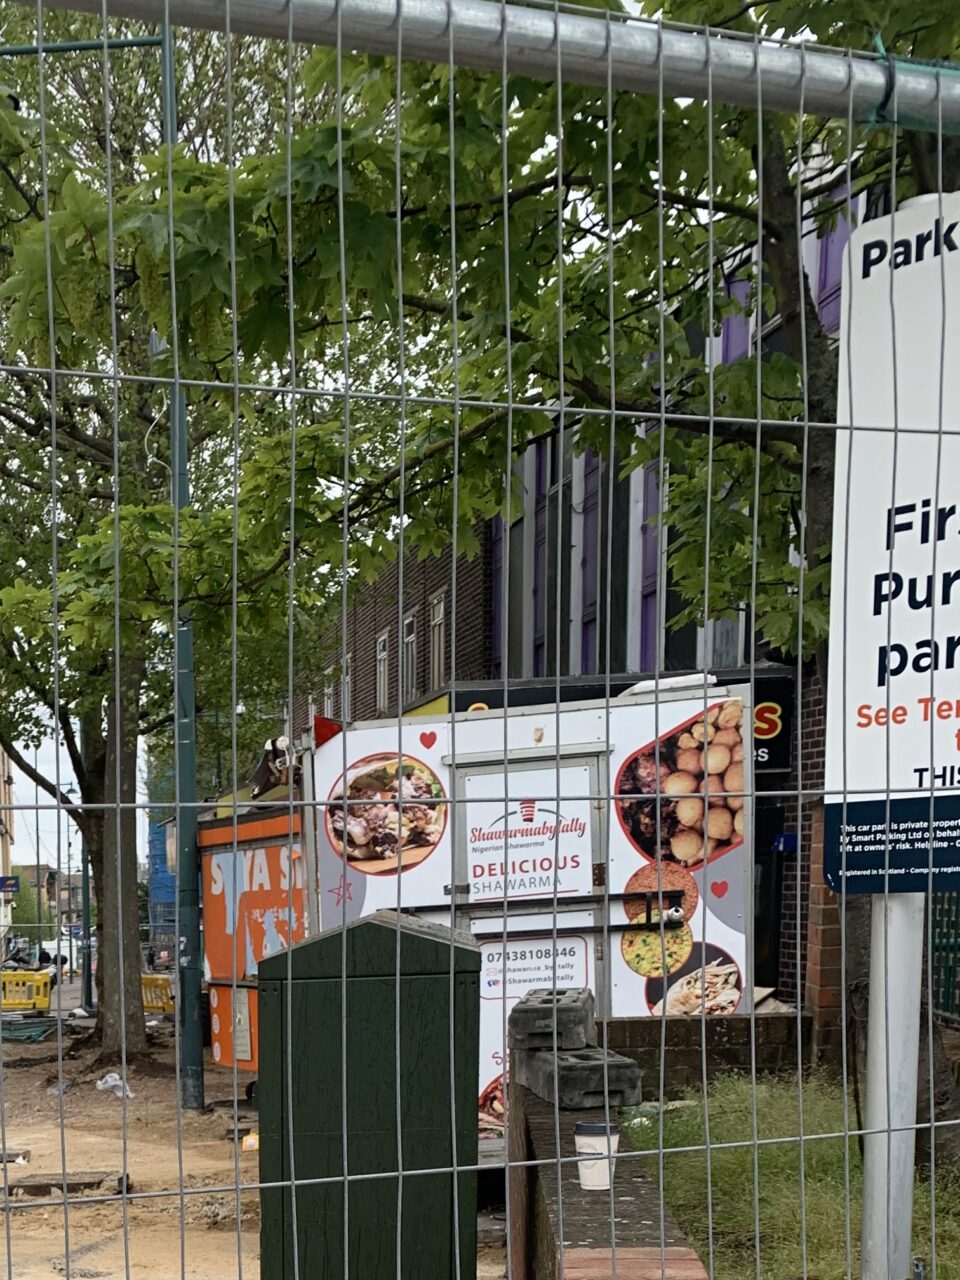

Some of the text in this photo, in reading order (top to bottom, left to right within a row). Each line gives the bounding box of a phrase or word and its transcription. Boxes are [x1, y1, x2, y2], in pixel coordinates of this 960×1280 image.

[861, 217, 959, 279] Park
[886, 498, 960, 550] Fir
[856, 704, 908, 728] See
[872, 823, 888, 833] par
[891, 822, 898, 830] is
[900, 821, 928, 831] private
[852, 834, 874, 843] Smart
[876, 831, 906, 842] Paking
[908, 831, 921, 839] Ltd
[936, 829, 960, 838] behal
[472, 845, 504, 854] Nigerian
[840, 844, 853, 853] lft
[854, 844, 862, 852] at
[864, 843, 895, 852] ownes'
[896, 842, 913, 850] risk.
[211, 849, 271, 895] SYA
[473, 855, 580, 878] DELICIOUS
[839, 869, 871, 877] Rgistered
[878, 868, 905, 876] Sctland
[910, 867, 940, 875] Compny
[473, 875, 562, 894] SHAWARMA
[502, 975, 574, 985] Shawarmabtally
